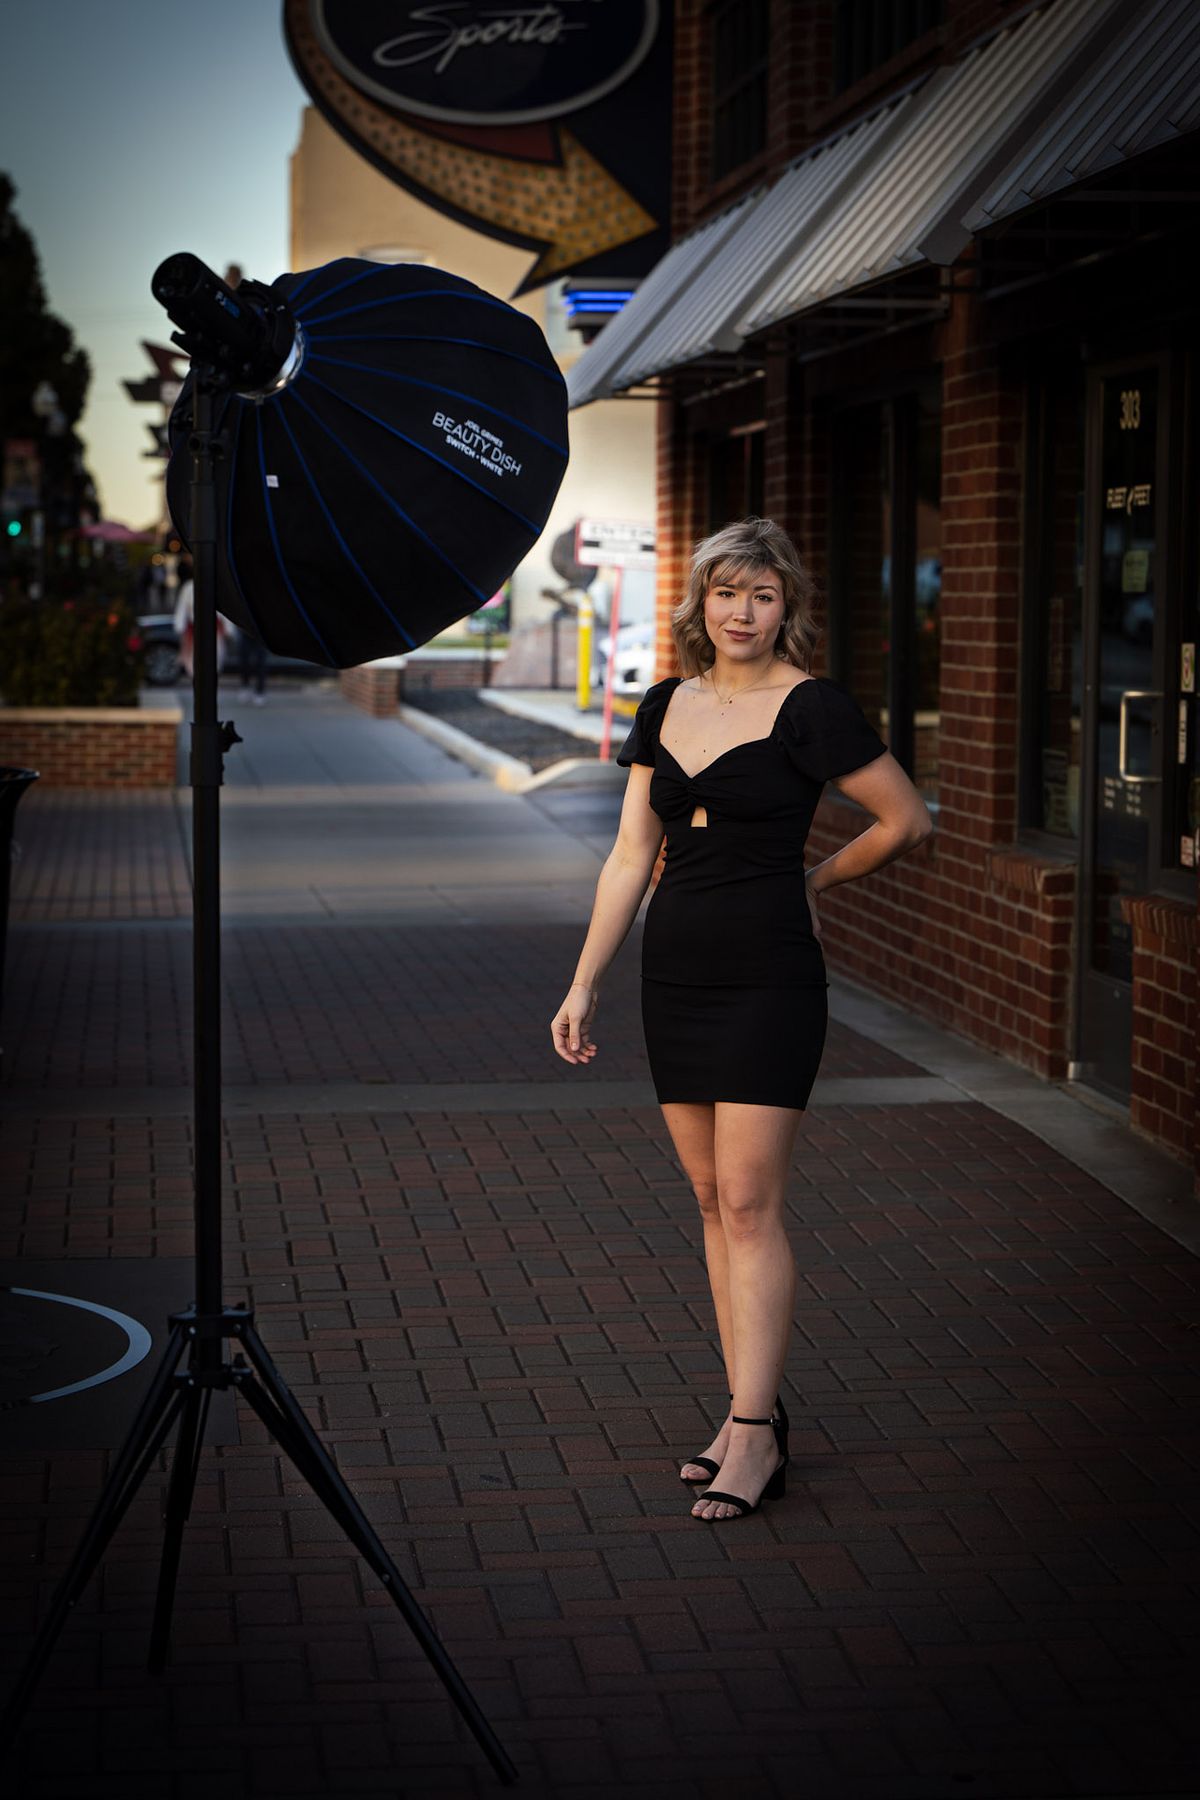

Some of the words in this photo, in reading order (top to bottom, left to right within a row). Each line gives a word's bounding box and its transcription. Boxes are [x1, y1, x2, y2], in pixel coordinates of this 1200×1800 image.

[372, 2, 589, 74] Sports
[431, 411, 492, 454] BEAUTY
[490, 446, 522, 476] DISH
[445, 434, 477, 459] SWITCH
[480, 455, 504, 477] WHITE
